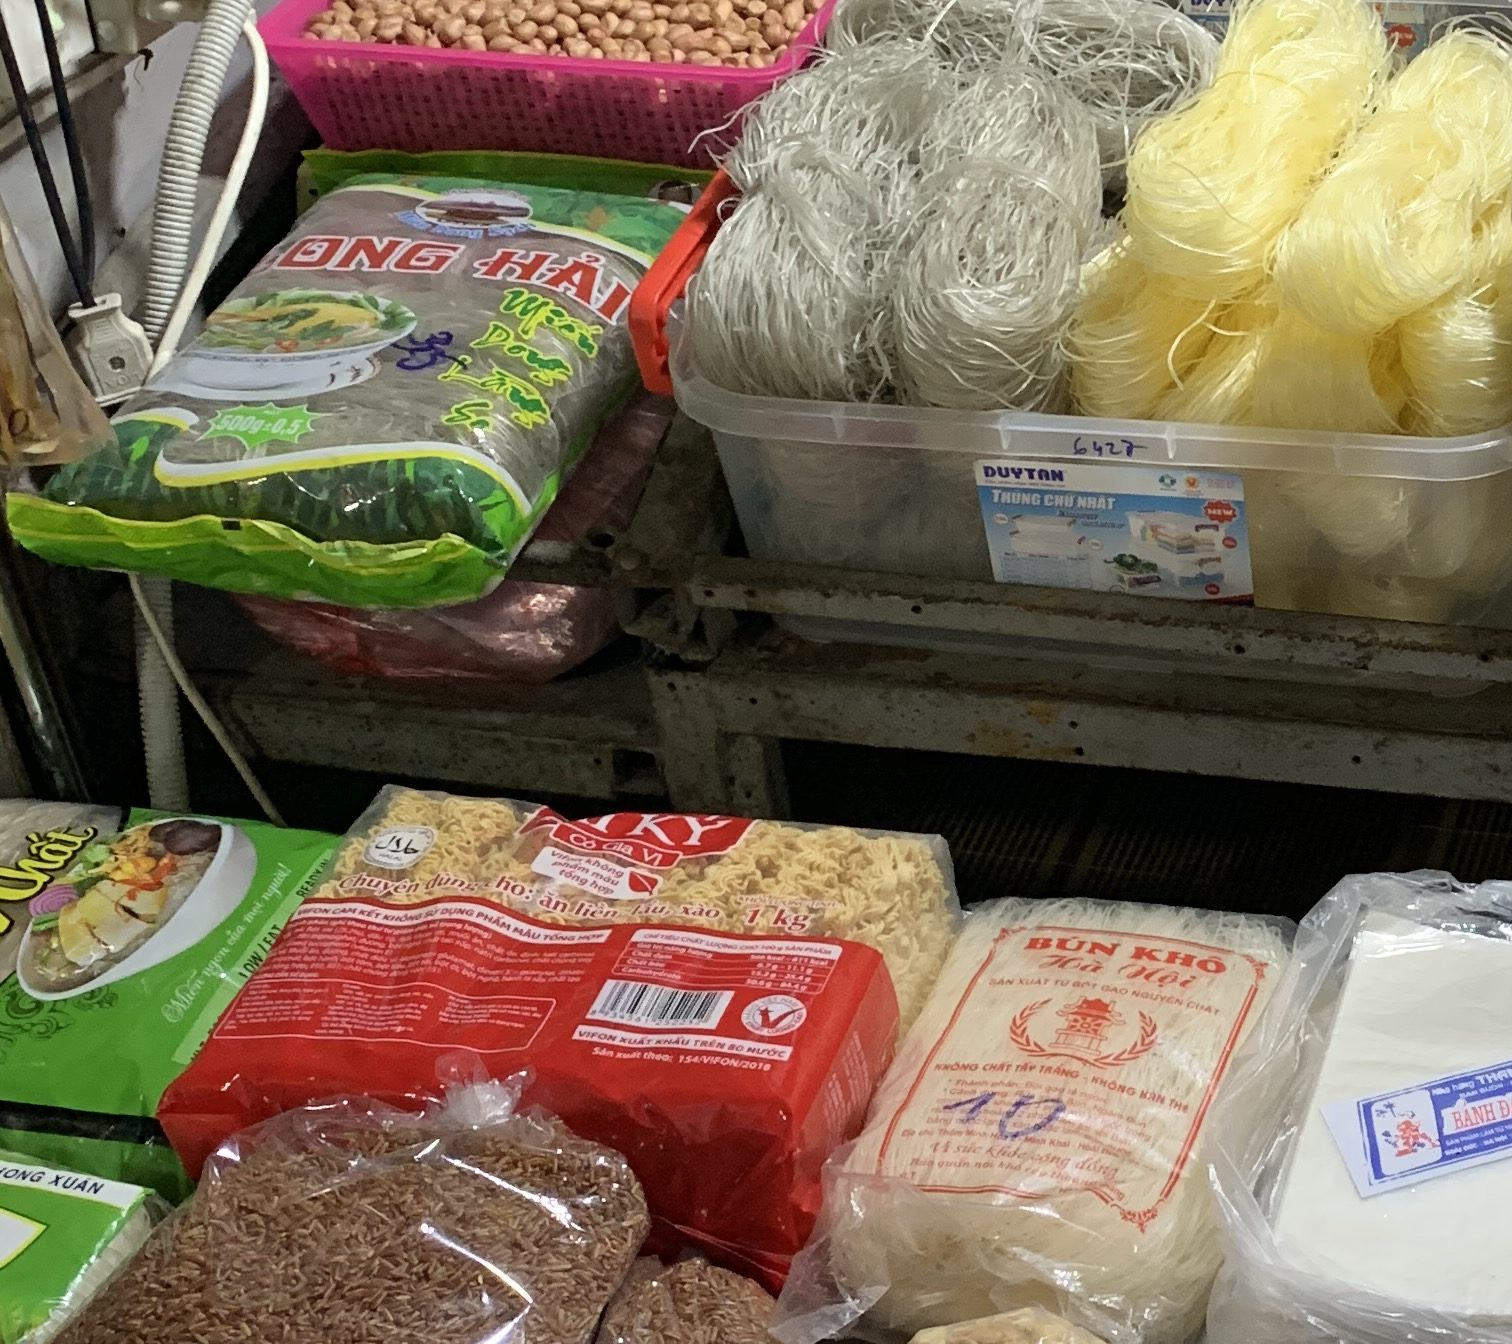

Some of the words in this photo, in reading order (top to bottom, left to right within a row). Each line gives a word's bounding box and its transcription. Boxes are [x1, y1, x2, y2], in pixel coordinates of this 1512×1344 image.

[473, 244, 632, 326] HẢI
[983, 465, 1065, 483] DUYTAN
[550, 859, 591, 880] phẩm
[592, 868, 621, 887] màu
[583, 854, 625, 880] không
[557, 867, 589, 889] tổng
[589, 878, 616, 897] hợp
[772, 907, 814, 933] kg
[202, 943, 231, 978] ngon
[1023, 936, 1122, 957] BÚN
[1129, 945, 1227, 974] KHÔ
[577, 1029, 618, 1042] VIFON
[692, 1037, 726, 1050] TRÊN
[48, 1172, 105, 1196] XUÂN
